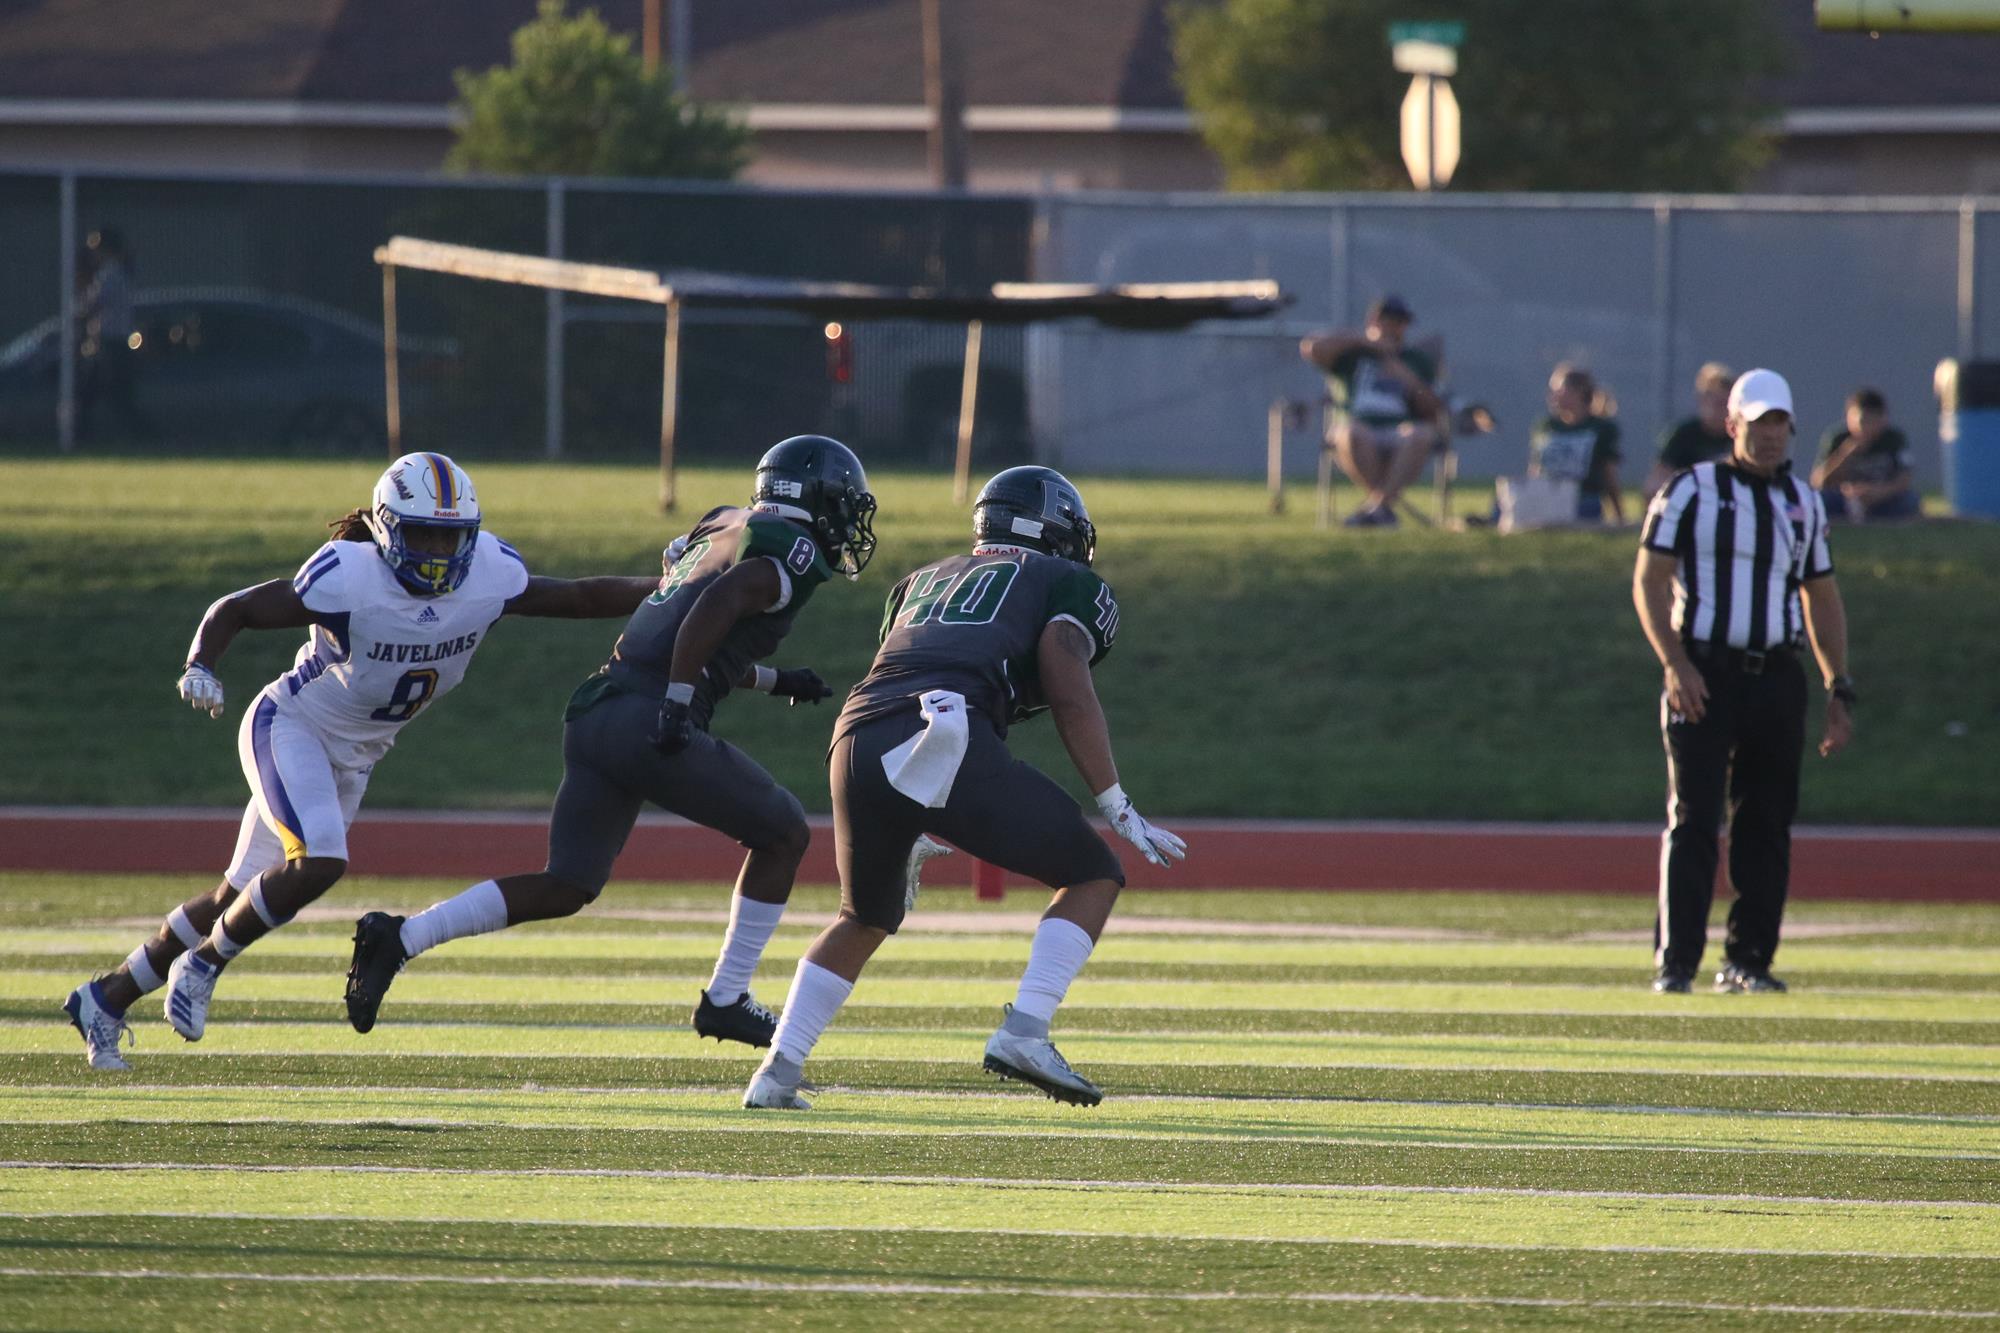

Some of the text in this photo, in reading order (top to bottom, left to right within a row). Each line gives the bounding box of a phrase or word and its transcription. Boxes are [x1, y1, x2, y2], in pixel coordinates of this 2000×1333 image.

[433, 510, 460, 518] Riddell
[787, 537, 816, 575] 8
[898, 561, 1020, 629] 40
[366, 631, 478, 663] JAVELINAS
[370, 667, 440, 722] 8
